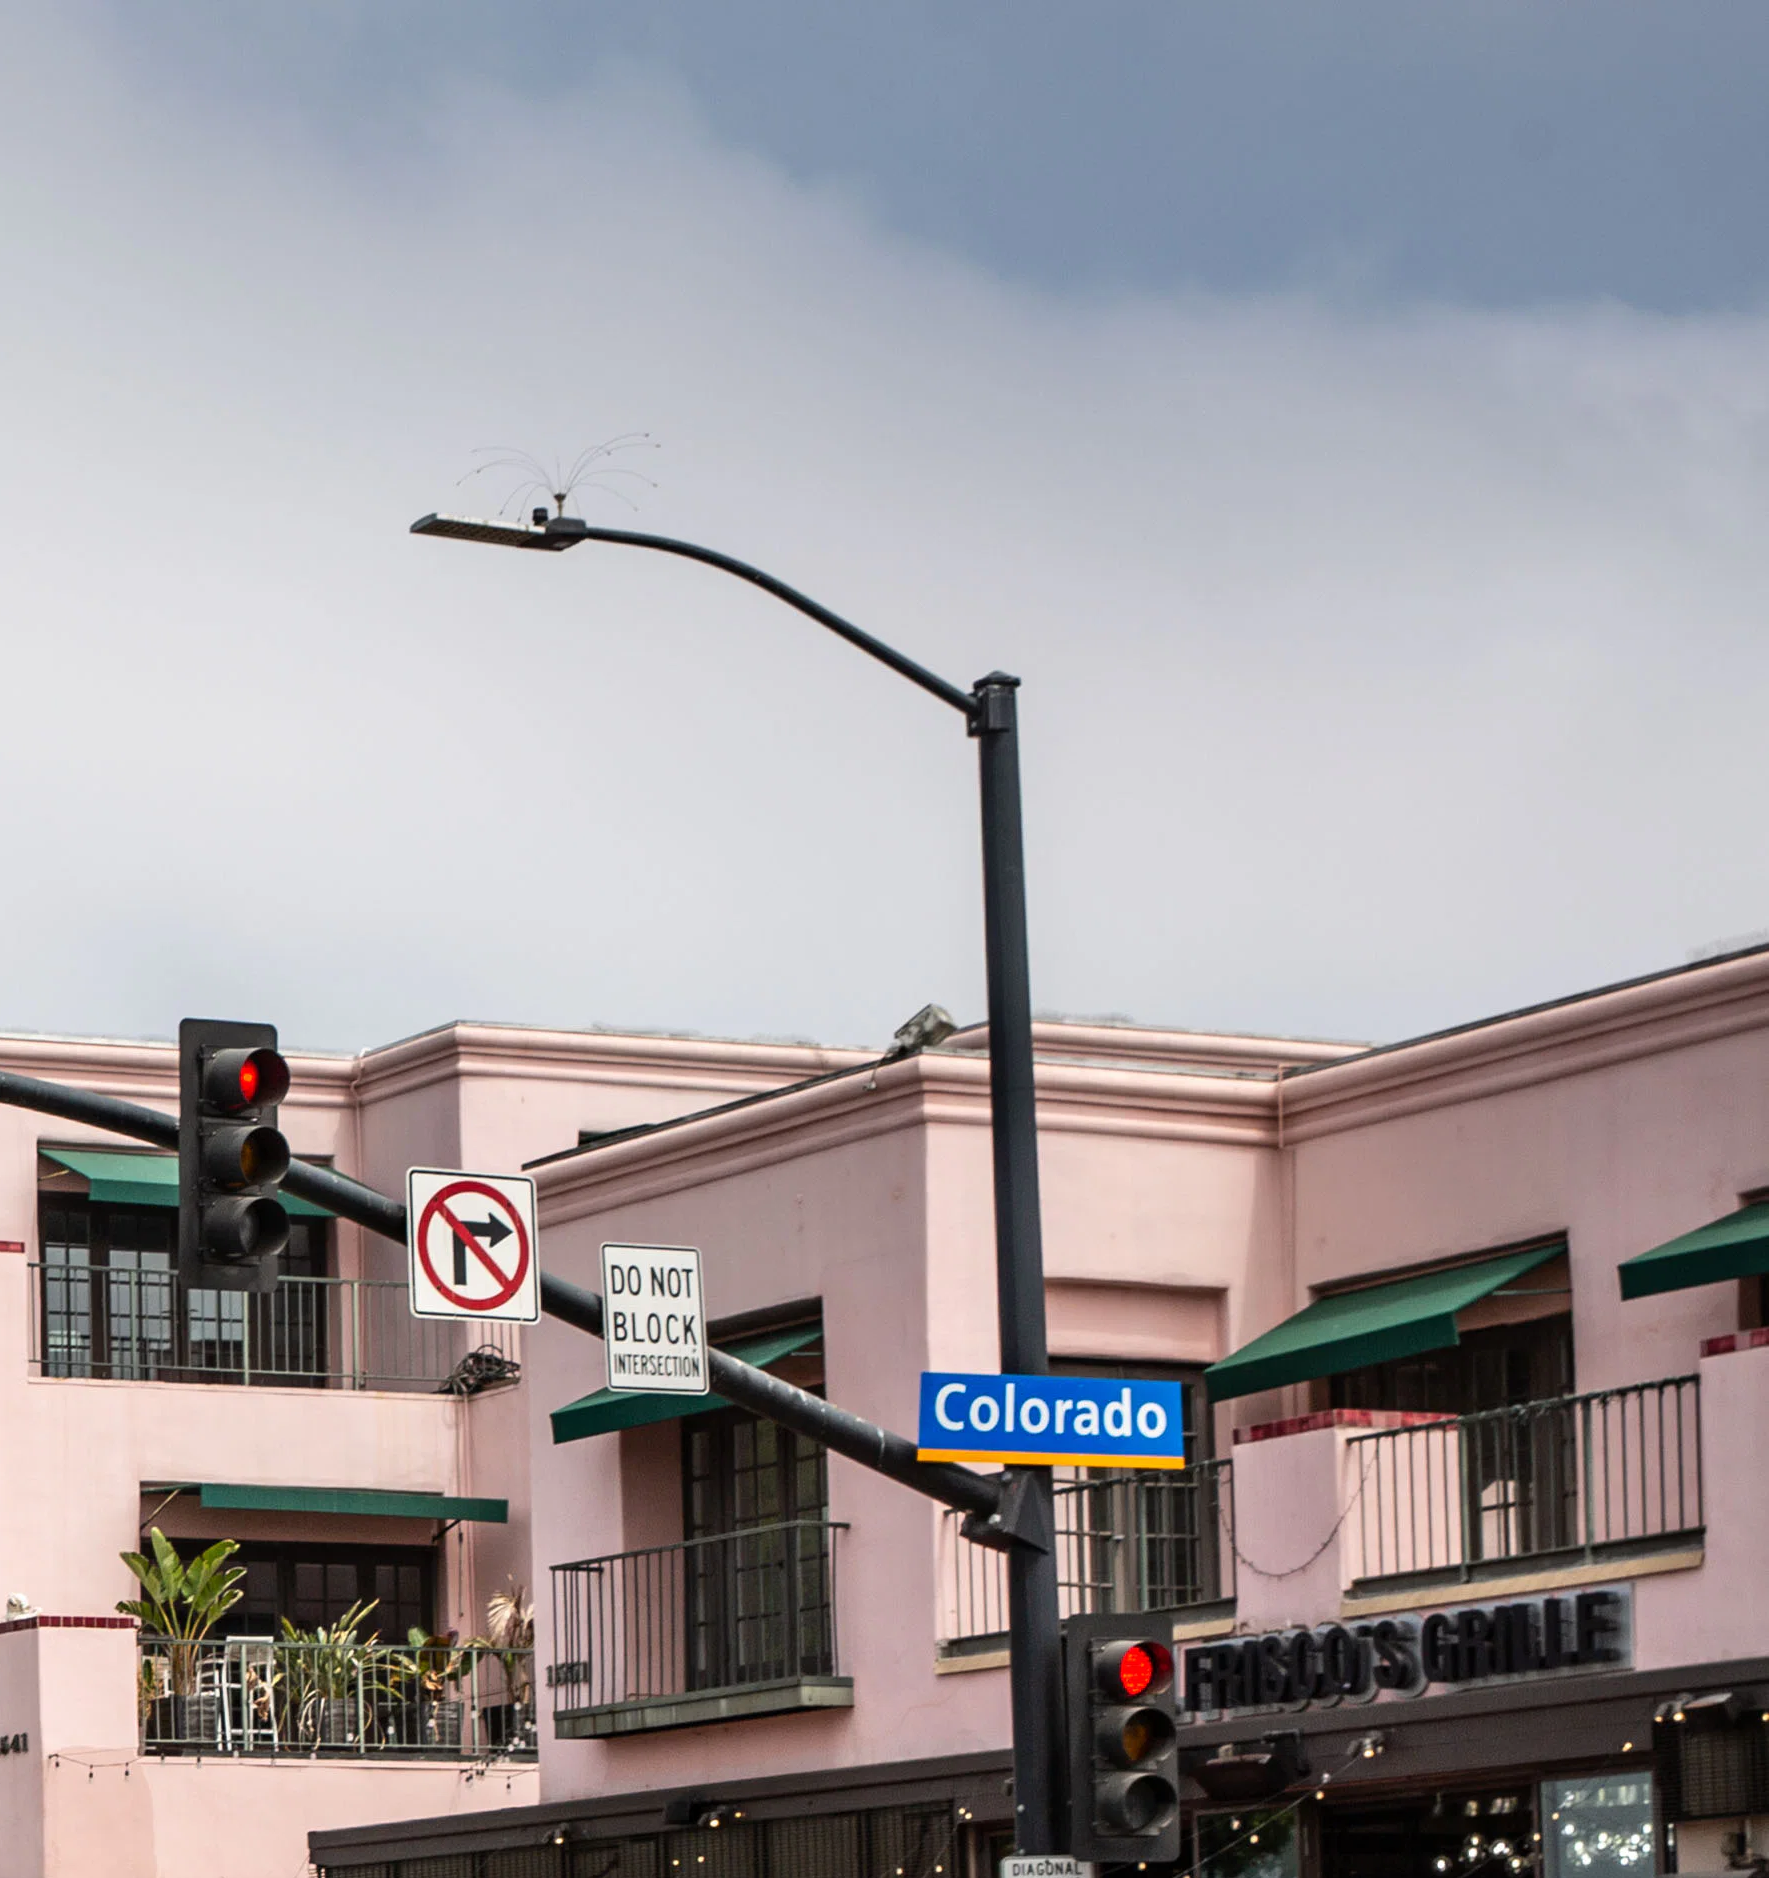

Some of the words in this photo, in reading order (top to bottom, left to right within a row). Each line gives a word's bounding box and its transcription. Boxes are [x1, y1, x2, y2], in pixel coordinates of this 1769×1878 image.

[611, 1264, 642, 1296] DO
[650, 1266, 694, 1299] NOT
[613, 1311, 698, 1345] BLOCK
[613, 1353, 701, 1378] INTERSECTION
[934, 1382, 1167, 1439] Colorado
[1184, 1618, 1413, 1711] FRISCO'S
[1421, 1591, 1621, 1684] GRILLE
[1012, 1860, 1083, 1878] DIAGONAL
